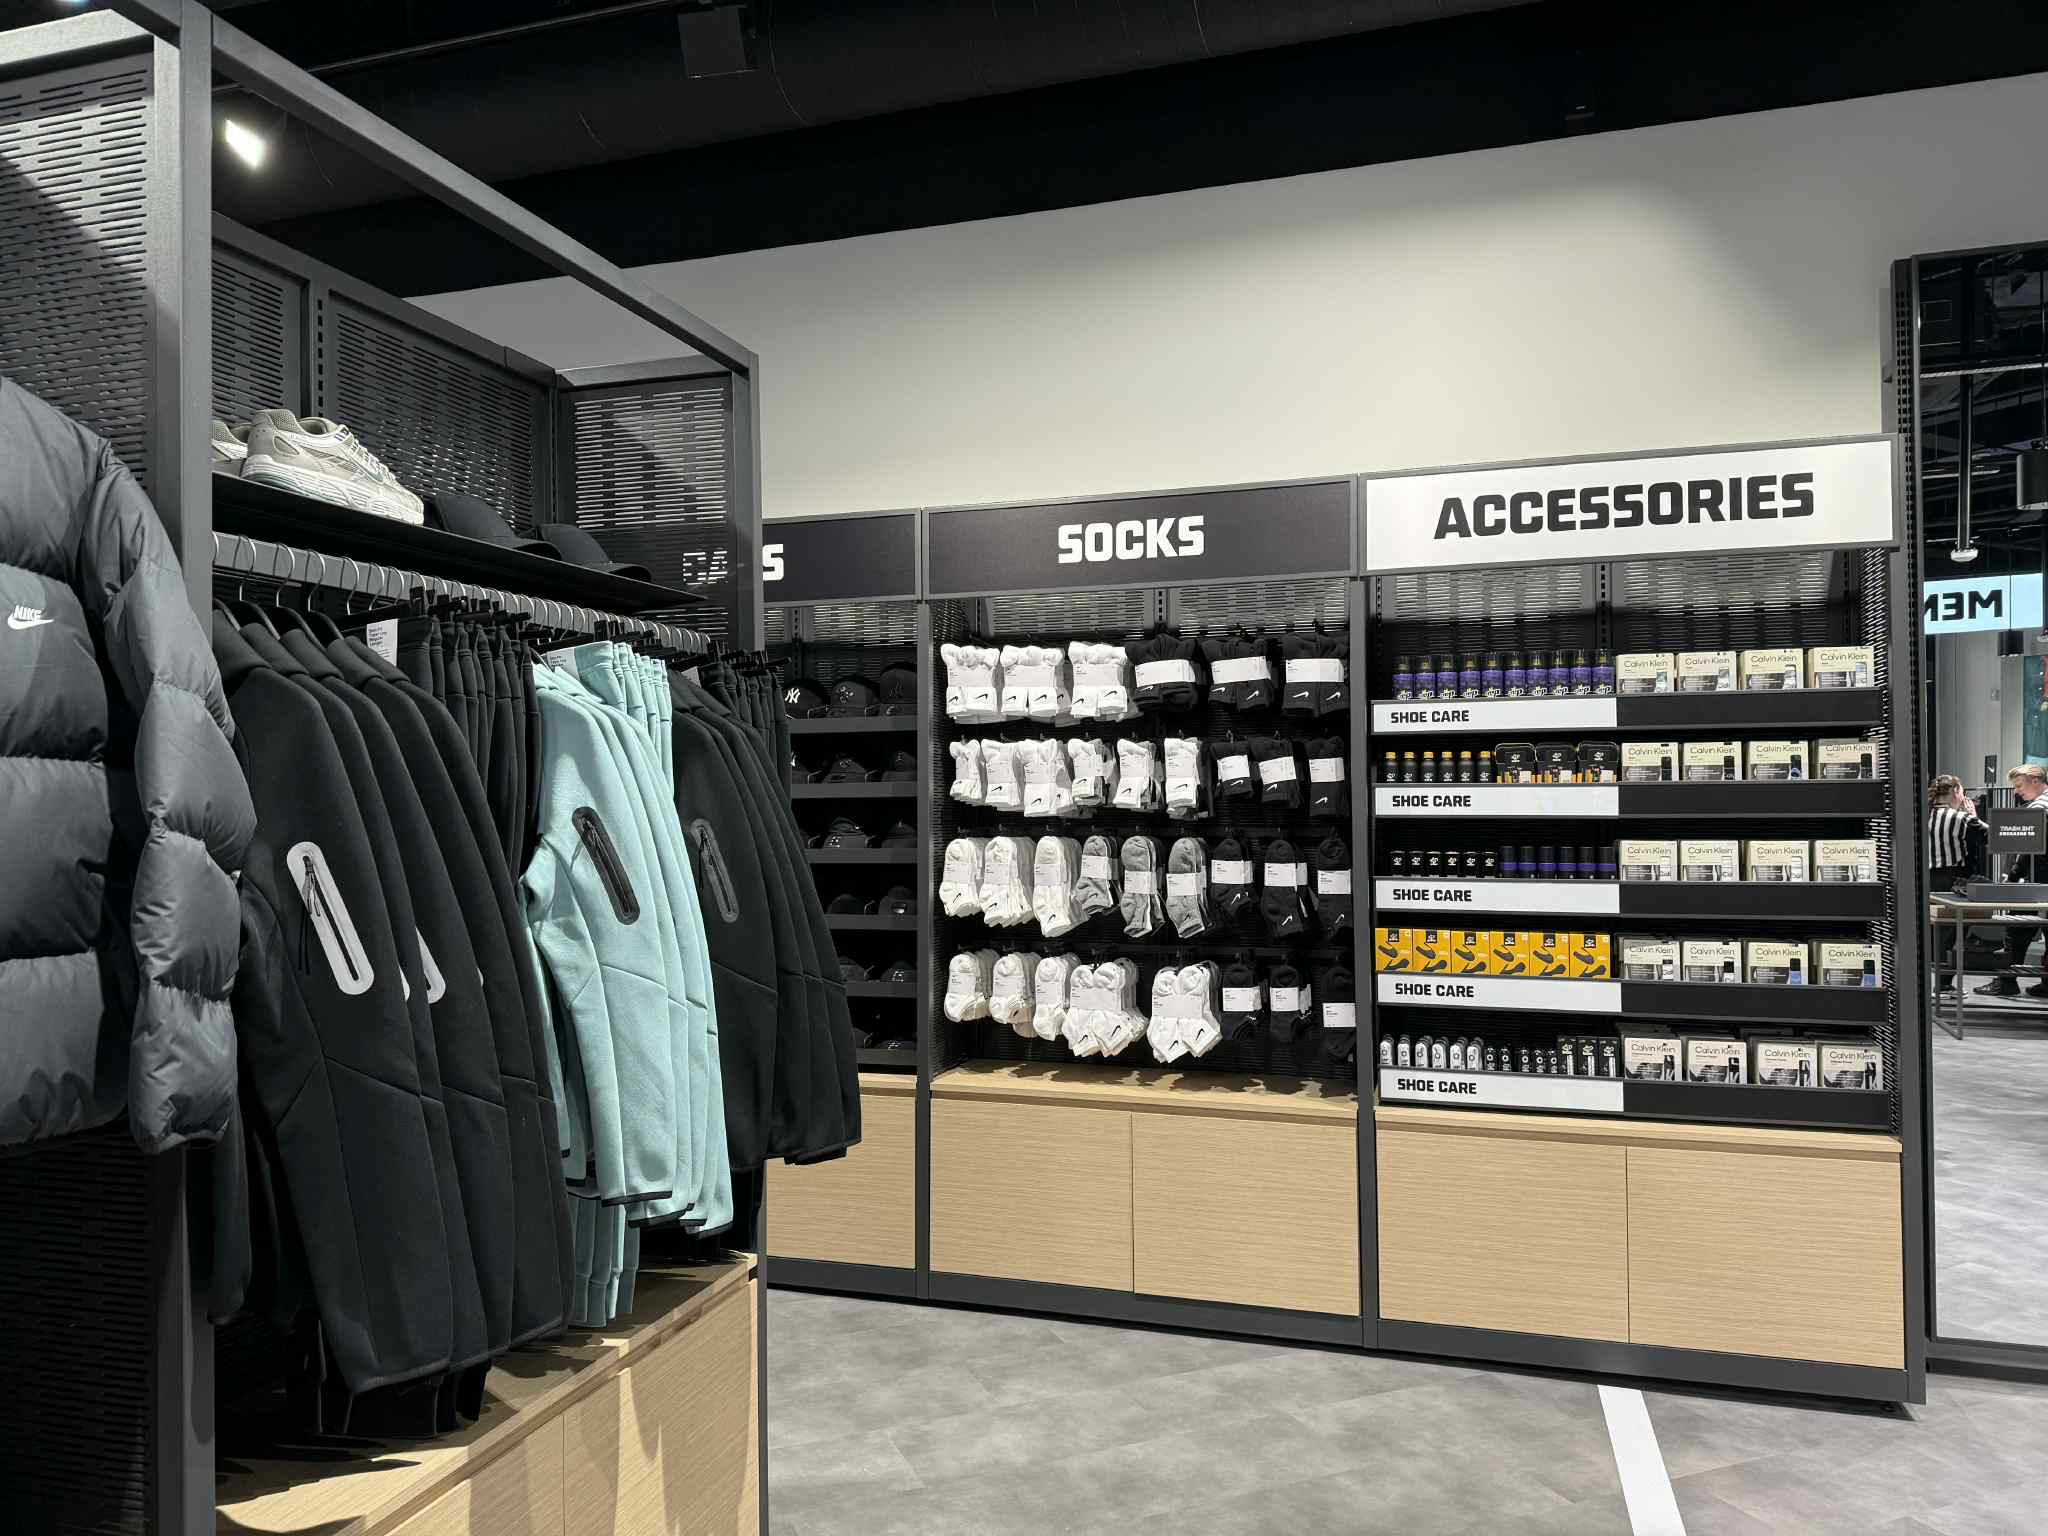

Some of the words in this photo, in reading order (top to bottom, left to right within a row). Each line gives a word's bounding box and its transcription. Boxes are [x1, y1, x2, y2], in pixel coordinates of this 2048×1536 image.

[1433, 472, 1814, 540] ACCESSORIES
[1058, 515, 1205, 564] SOCKS
[14, 605, 42, 620] NIKE
[1391, 711, 1428, 723] SHOE
[1431, 710, 1470, 722] CARE
[1392, 795, 1429, 807] SHOE
[1433, 795, 1472, 807] CARE
[1393, 889, 1429, 901] SHOE
[1434, 889, 1472, 902] CARE
[1395, 983, 1432, 996] SHOE
[1436, 984, 1475, 998] CARE
[1397, 1078, 1434, 1092] SHOE
[1439, 1080, 1477, 1095] CARE
